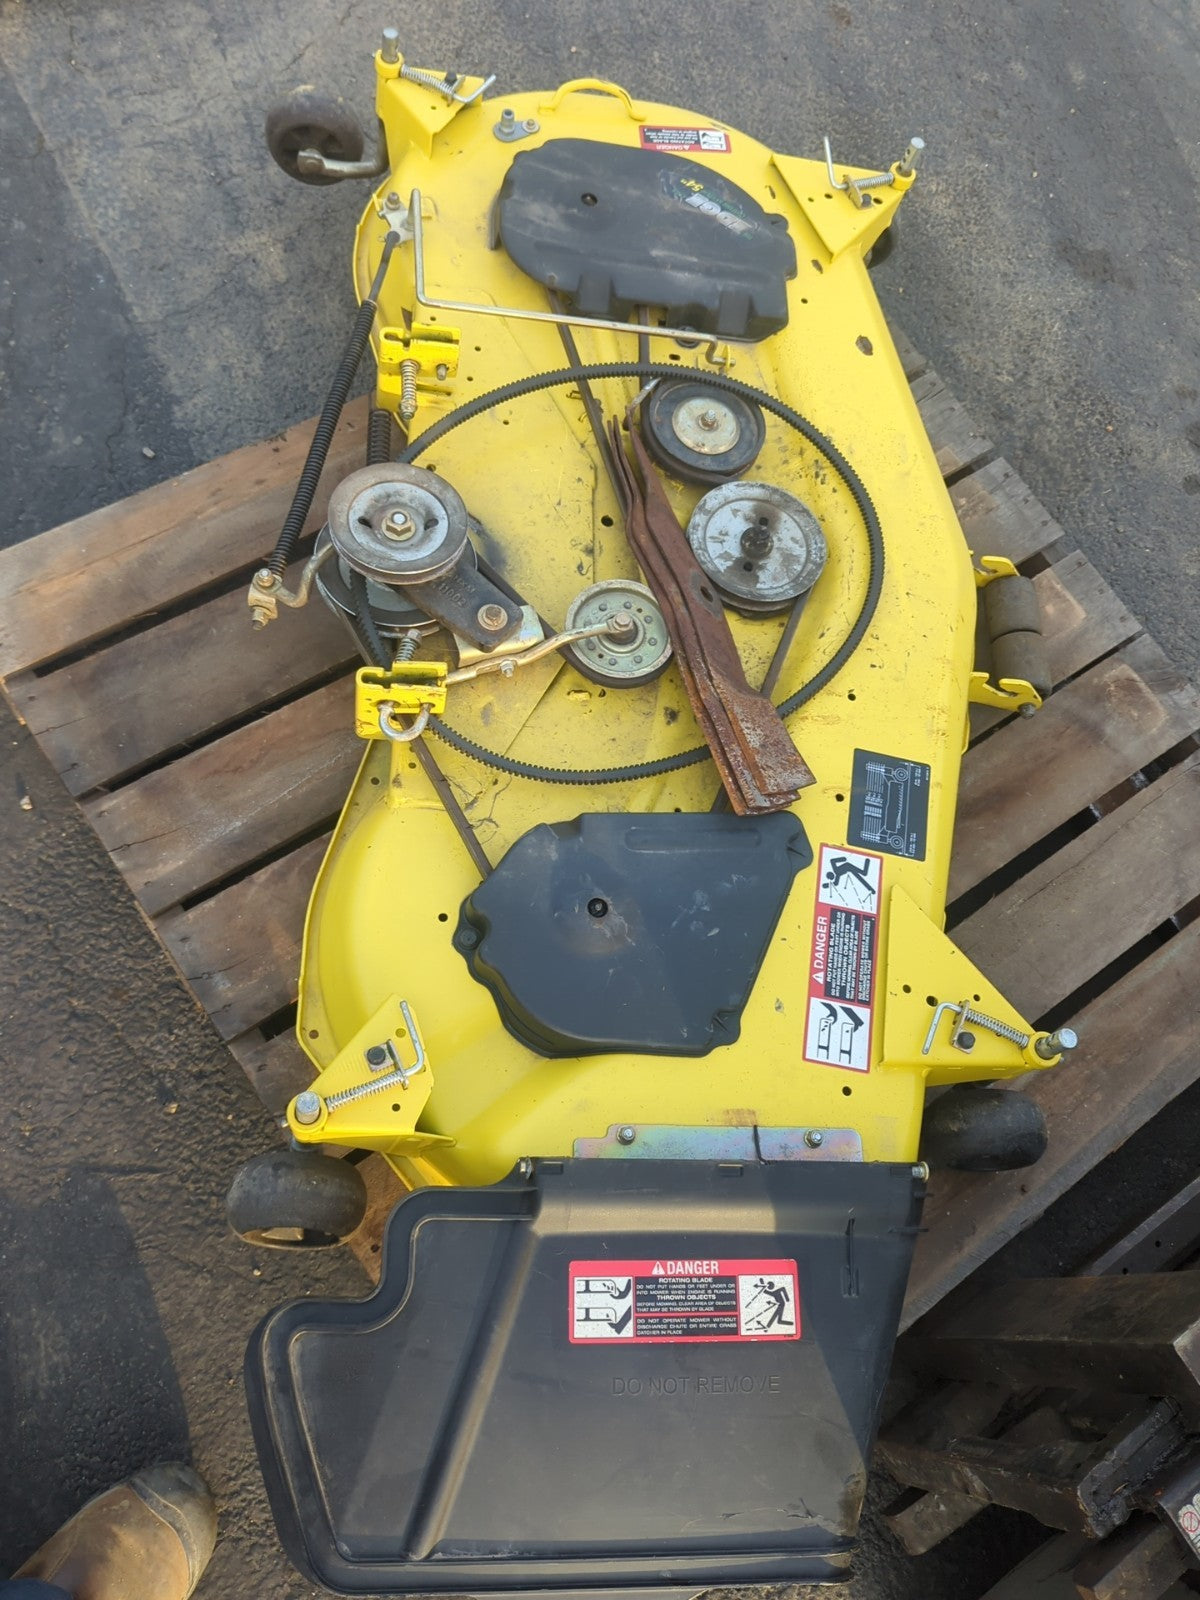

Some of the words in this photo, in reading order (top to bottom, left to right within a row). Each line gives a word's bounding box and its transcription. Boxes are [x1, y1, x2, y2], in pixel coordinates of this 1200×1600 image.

[814, 916, 827, 969] DANGER
[667, 1261, 719, 1274] DANGER
[612, 1377, 642, 1395] DO
[649, 1376, 690, 1395] NOT
[697, 1376, 781, 1394] REMOVE
